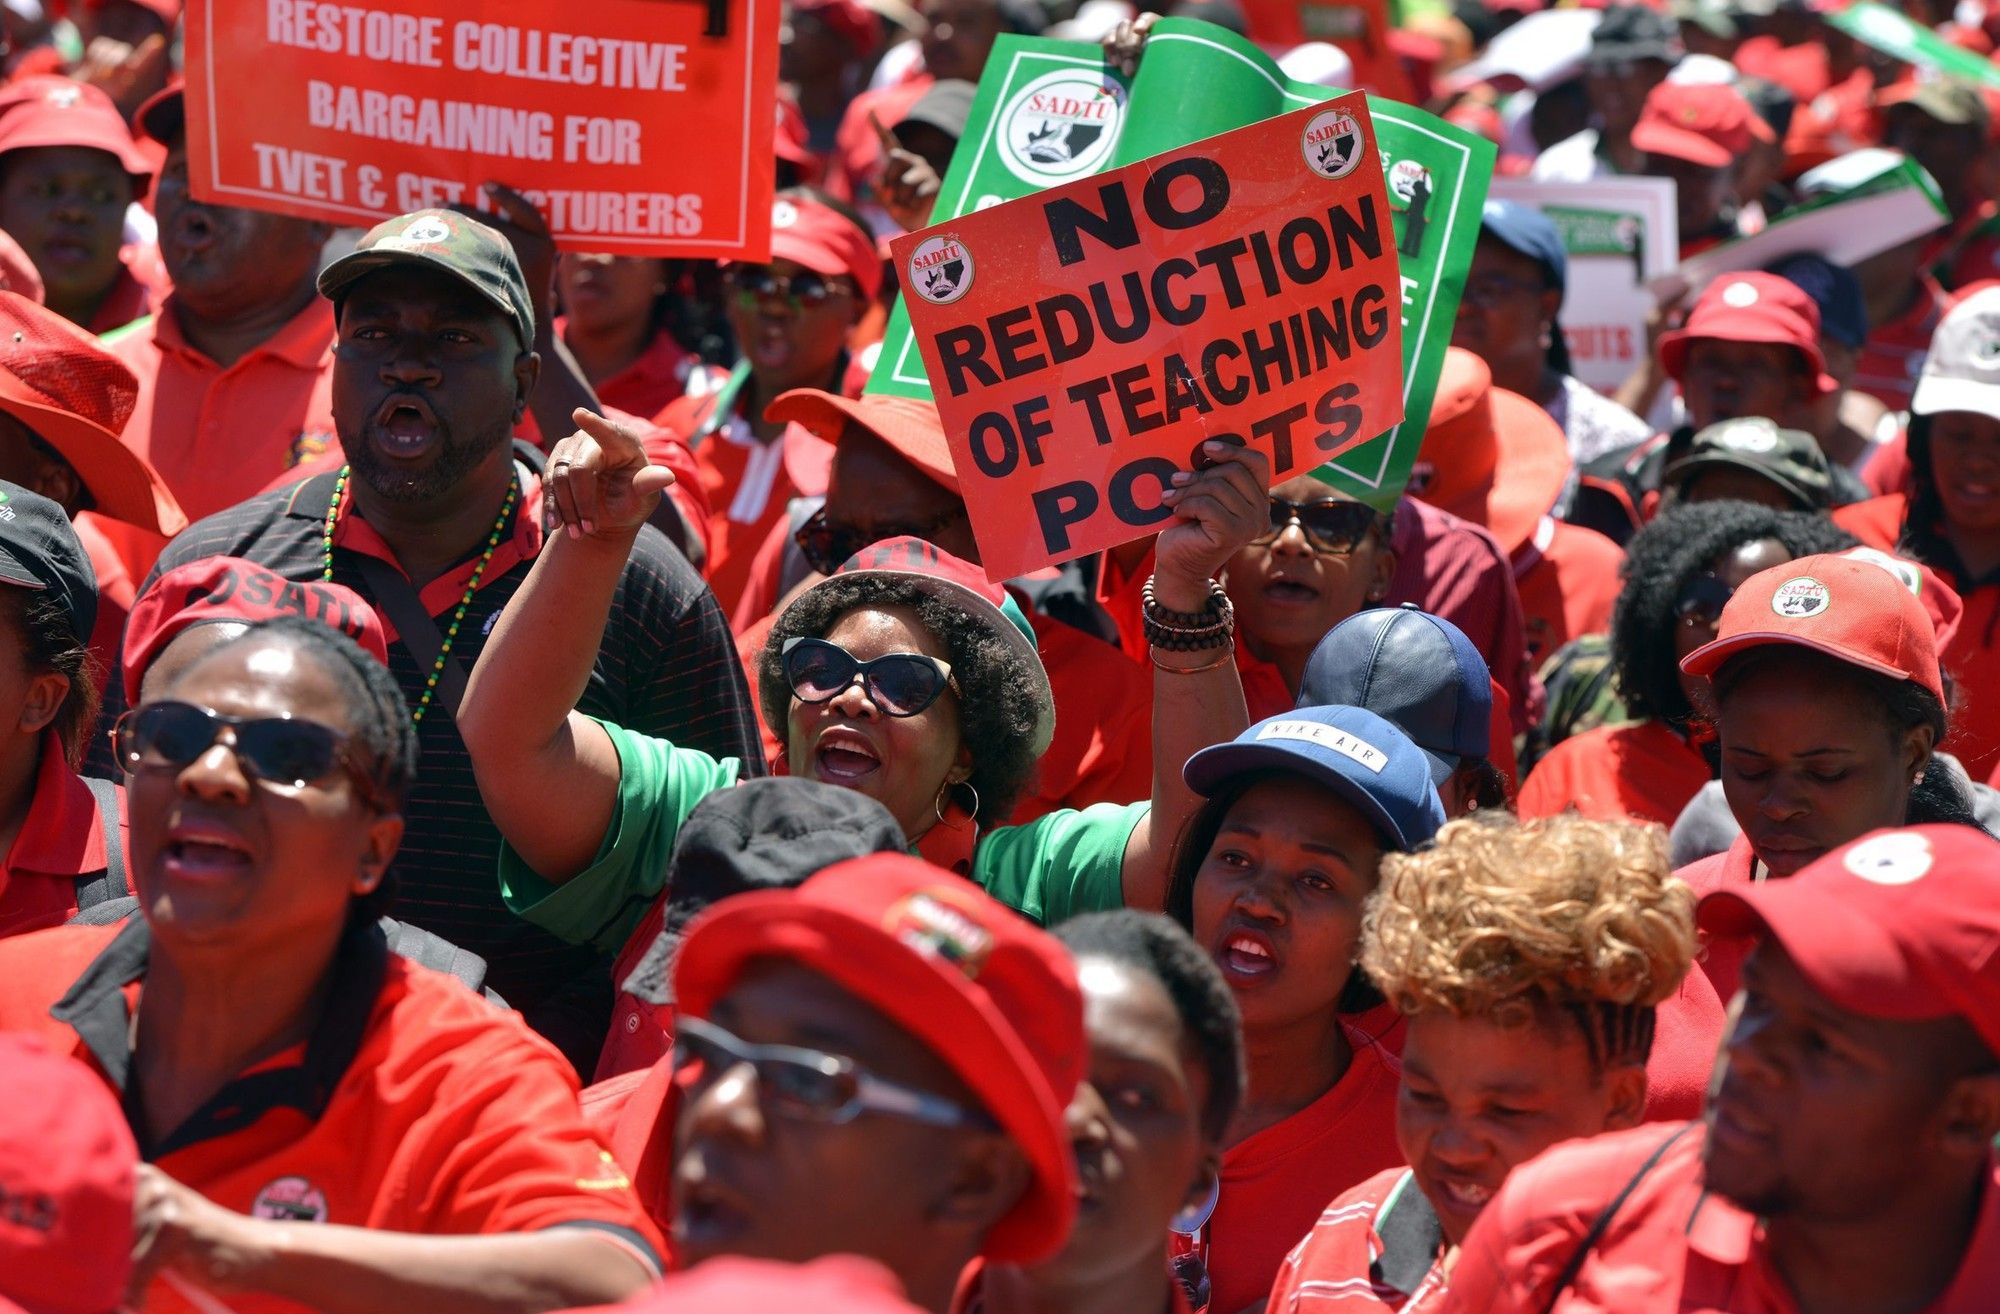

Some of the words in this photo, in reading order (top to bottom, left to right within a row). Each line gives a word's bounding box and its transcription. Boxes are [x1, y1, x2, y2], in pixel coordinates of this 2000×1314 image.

[266, 0, 444, 68] RESTORE
[453, 20, 688, 92] COLLECTIVE
[307, 78, 554, 162] BARGAINING
[563, 114, 642, 166] FOR
[1028, 93, 1112, 120] SADTU
[1305, 118, 1353, 146] SADTU
[252, 142, 348, 201] TVET
[357, 163, 388, 209] &
[475, 183, 703, 236] TURERS
[1042, 156, 1232, 269] NO
[912, 243, 962, 271] SADTU
[933, 193, 1384, 399] REDUCTION
[968, 394, 1055, 479] OF
[1066, 283, 1390, 447] TEACHING
[1781, 584, 1824, 597] SADTU
[1271, 724, 1323, 738] NIKE
[1335, 736, 1375, 761] AIR
